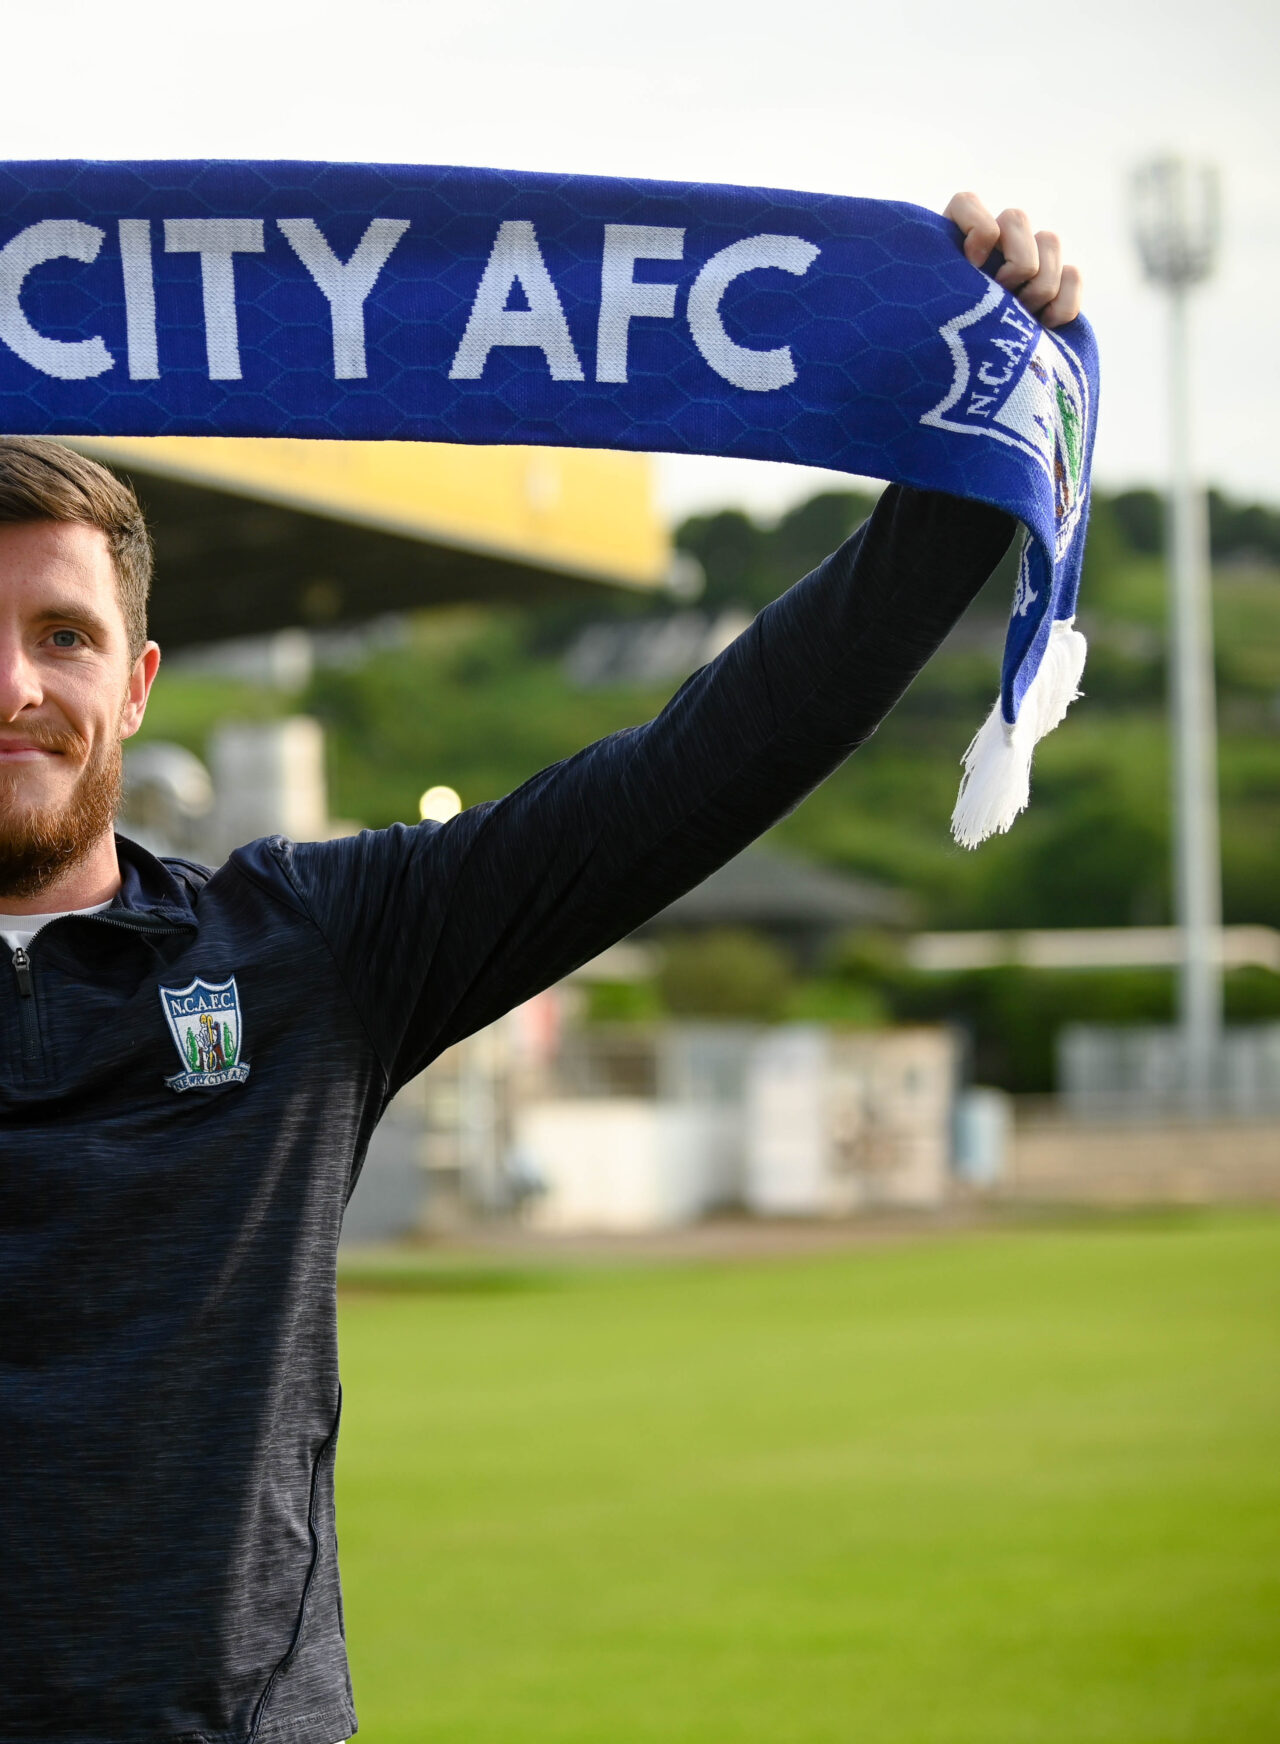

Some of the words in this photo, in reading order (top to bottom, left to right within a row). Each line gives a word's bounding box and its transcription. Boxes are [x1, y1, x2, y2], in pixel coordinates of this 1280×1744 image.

[448, 220, 823, 393] AFC
[169, 992, 235, 1016] N.C.A.F.C.
[208, 1070, 230, 1085] CITY
